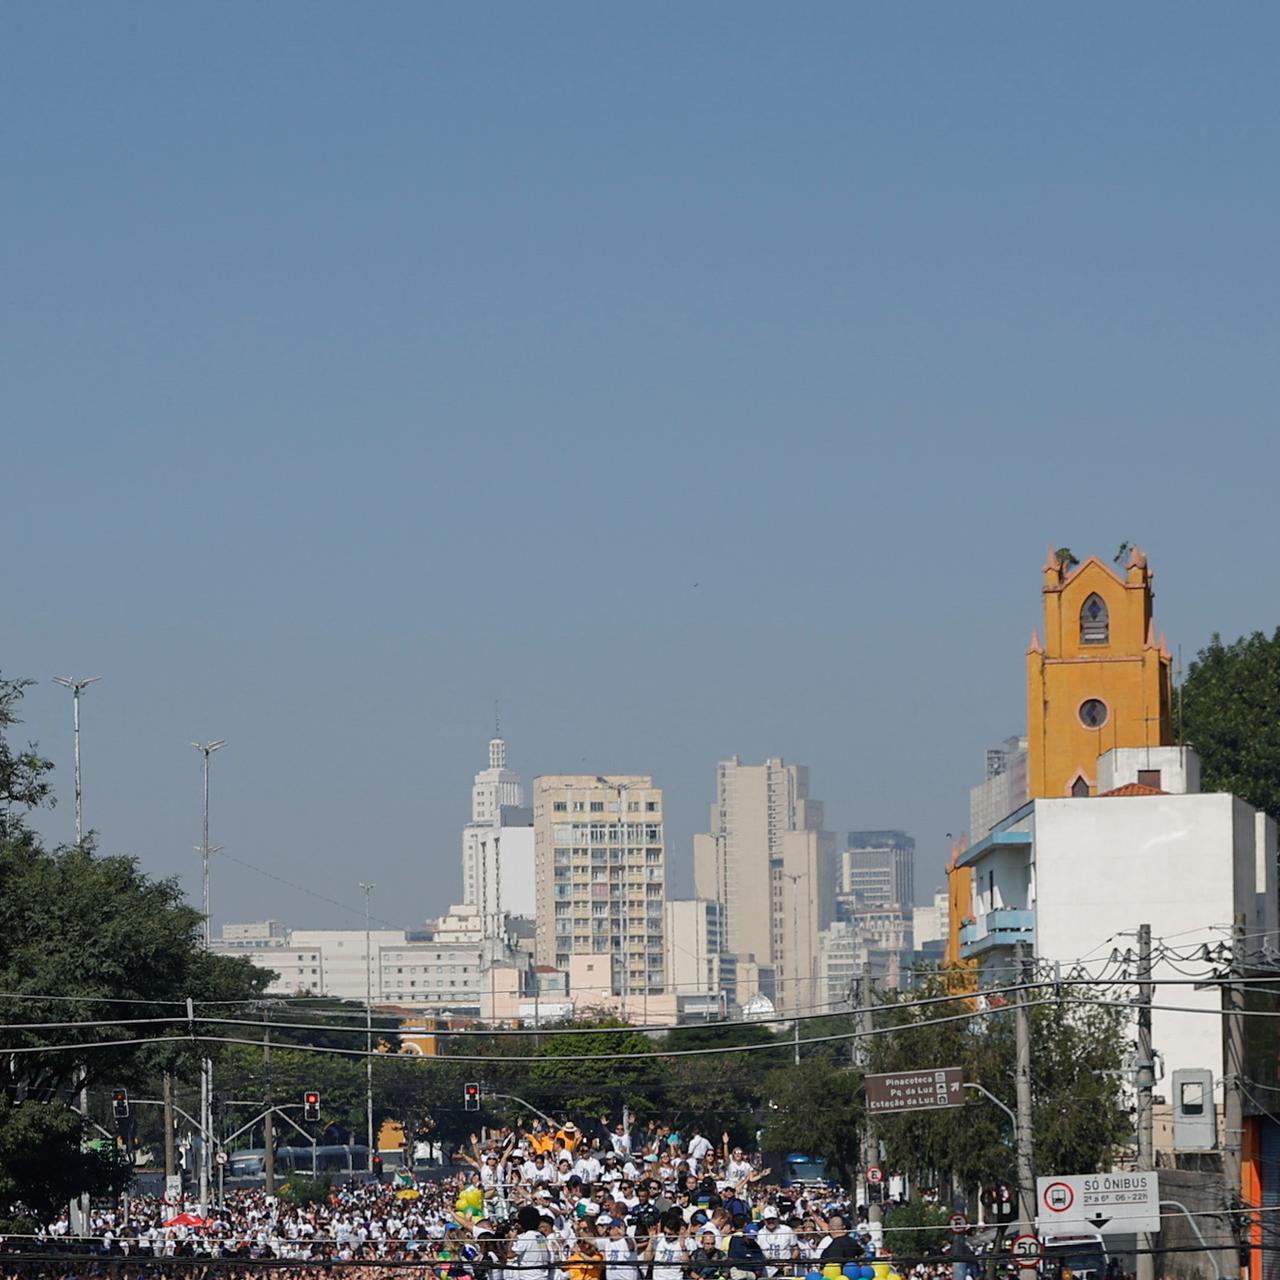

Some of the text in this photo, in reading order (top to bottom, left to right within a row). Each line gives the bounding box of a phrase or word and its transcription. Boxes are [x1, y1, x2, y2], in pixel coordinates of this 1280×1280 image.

[885, 1076, 932, 1086] Pinacoteca
[917, 1086, 933, 1094] Luz
[870, 1096, 934, 1108] Estação da Luz
[1084, 1176, 1147, 1190] SÓ ÔNIBUS
